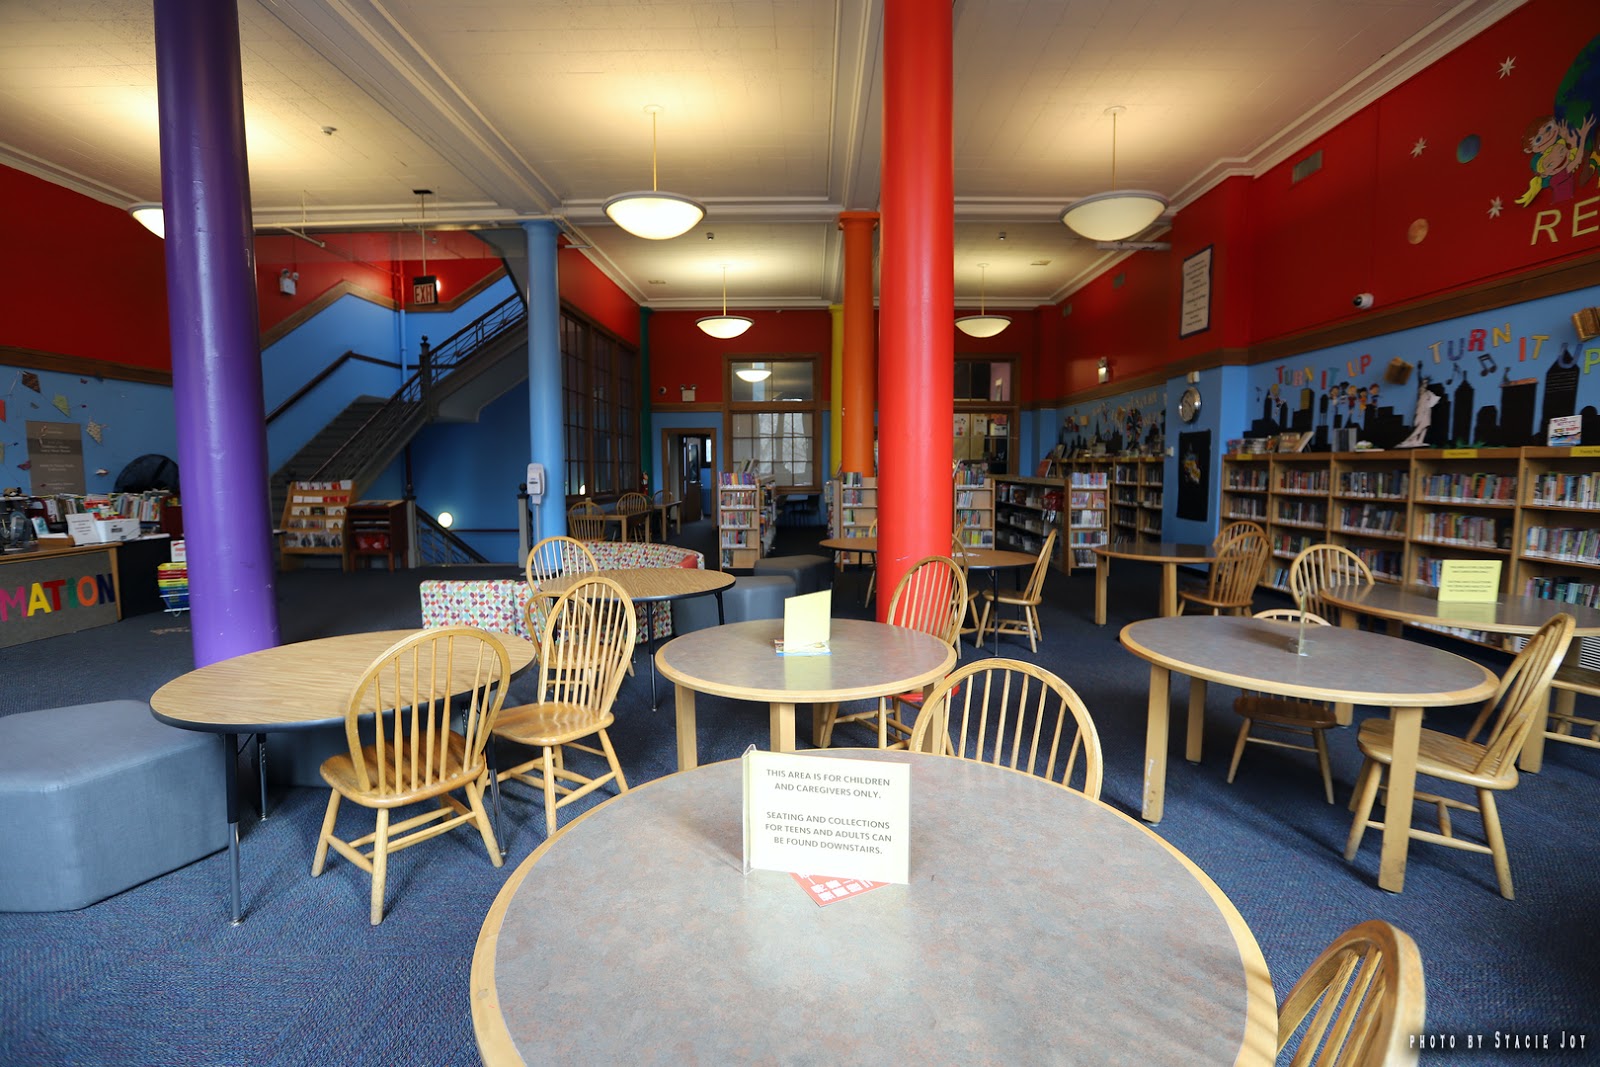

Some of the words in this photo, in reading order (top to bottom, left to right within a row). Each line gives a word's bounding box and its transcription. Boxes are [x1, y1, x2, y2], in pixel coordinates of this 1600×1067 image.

[414, 284, 433, 304] EXIT
[1428, 322, 1512, 364] TURN
[1519, 335, 1549, 362] IT
[1558, 342, 1600, 374] UP
[1275, 365, 1314, 387] TURN
[1321, 367, 1339, 390] IT
[1346, 353, 1372, 378] UP
[766, 768, 786, 778] THIS
[788, 771, 812, 780] AREA
[813, 773, 822, 781] IS
[823, 774, 842, 783] FOR
[843, 775, 890, 786] CHILDREN
[774, 782, 795, 791] AND
[796, 784, 852, 796] CAREGIVERS
[853, 789, 882, 799] ONLY.
[766, 811, 804, 822] SEATING
[806, 815, 826, 824] AND
[828, 817, 890, 830] COLLECTIONS
[765, 823, 783, 832] FOR
[784, 825, 811, 835] TEENS
[813, 828, 833, 837] AND
[835, 830, 870, 841] ADULTS
[872, 833, 892, 842] CAN
[774, 836, 784, 845] BE
[786, 837, 819, 848] FOUND
[820, 841, 883, 855] DOWNSTAIRS.
